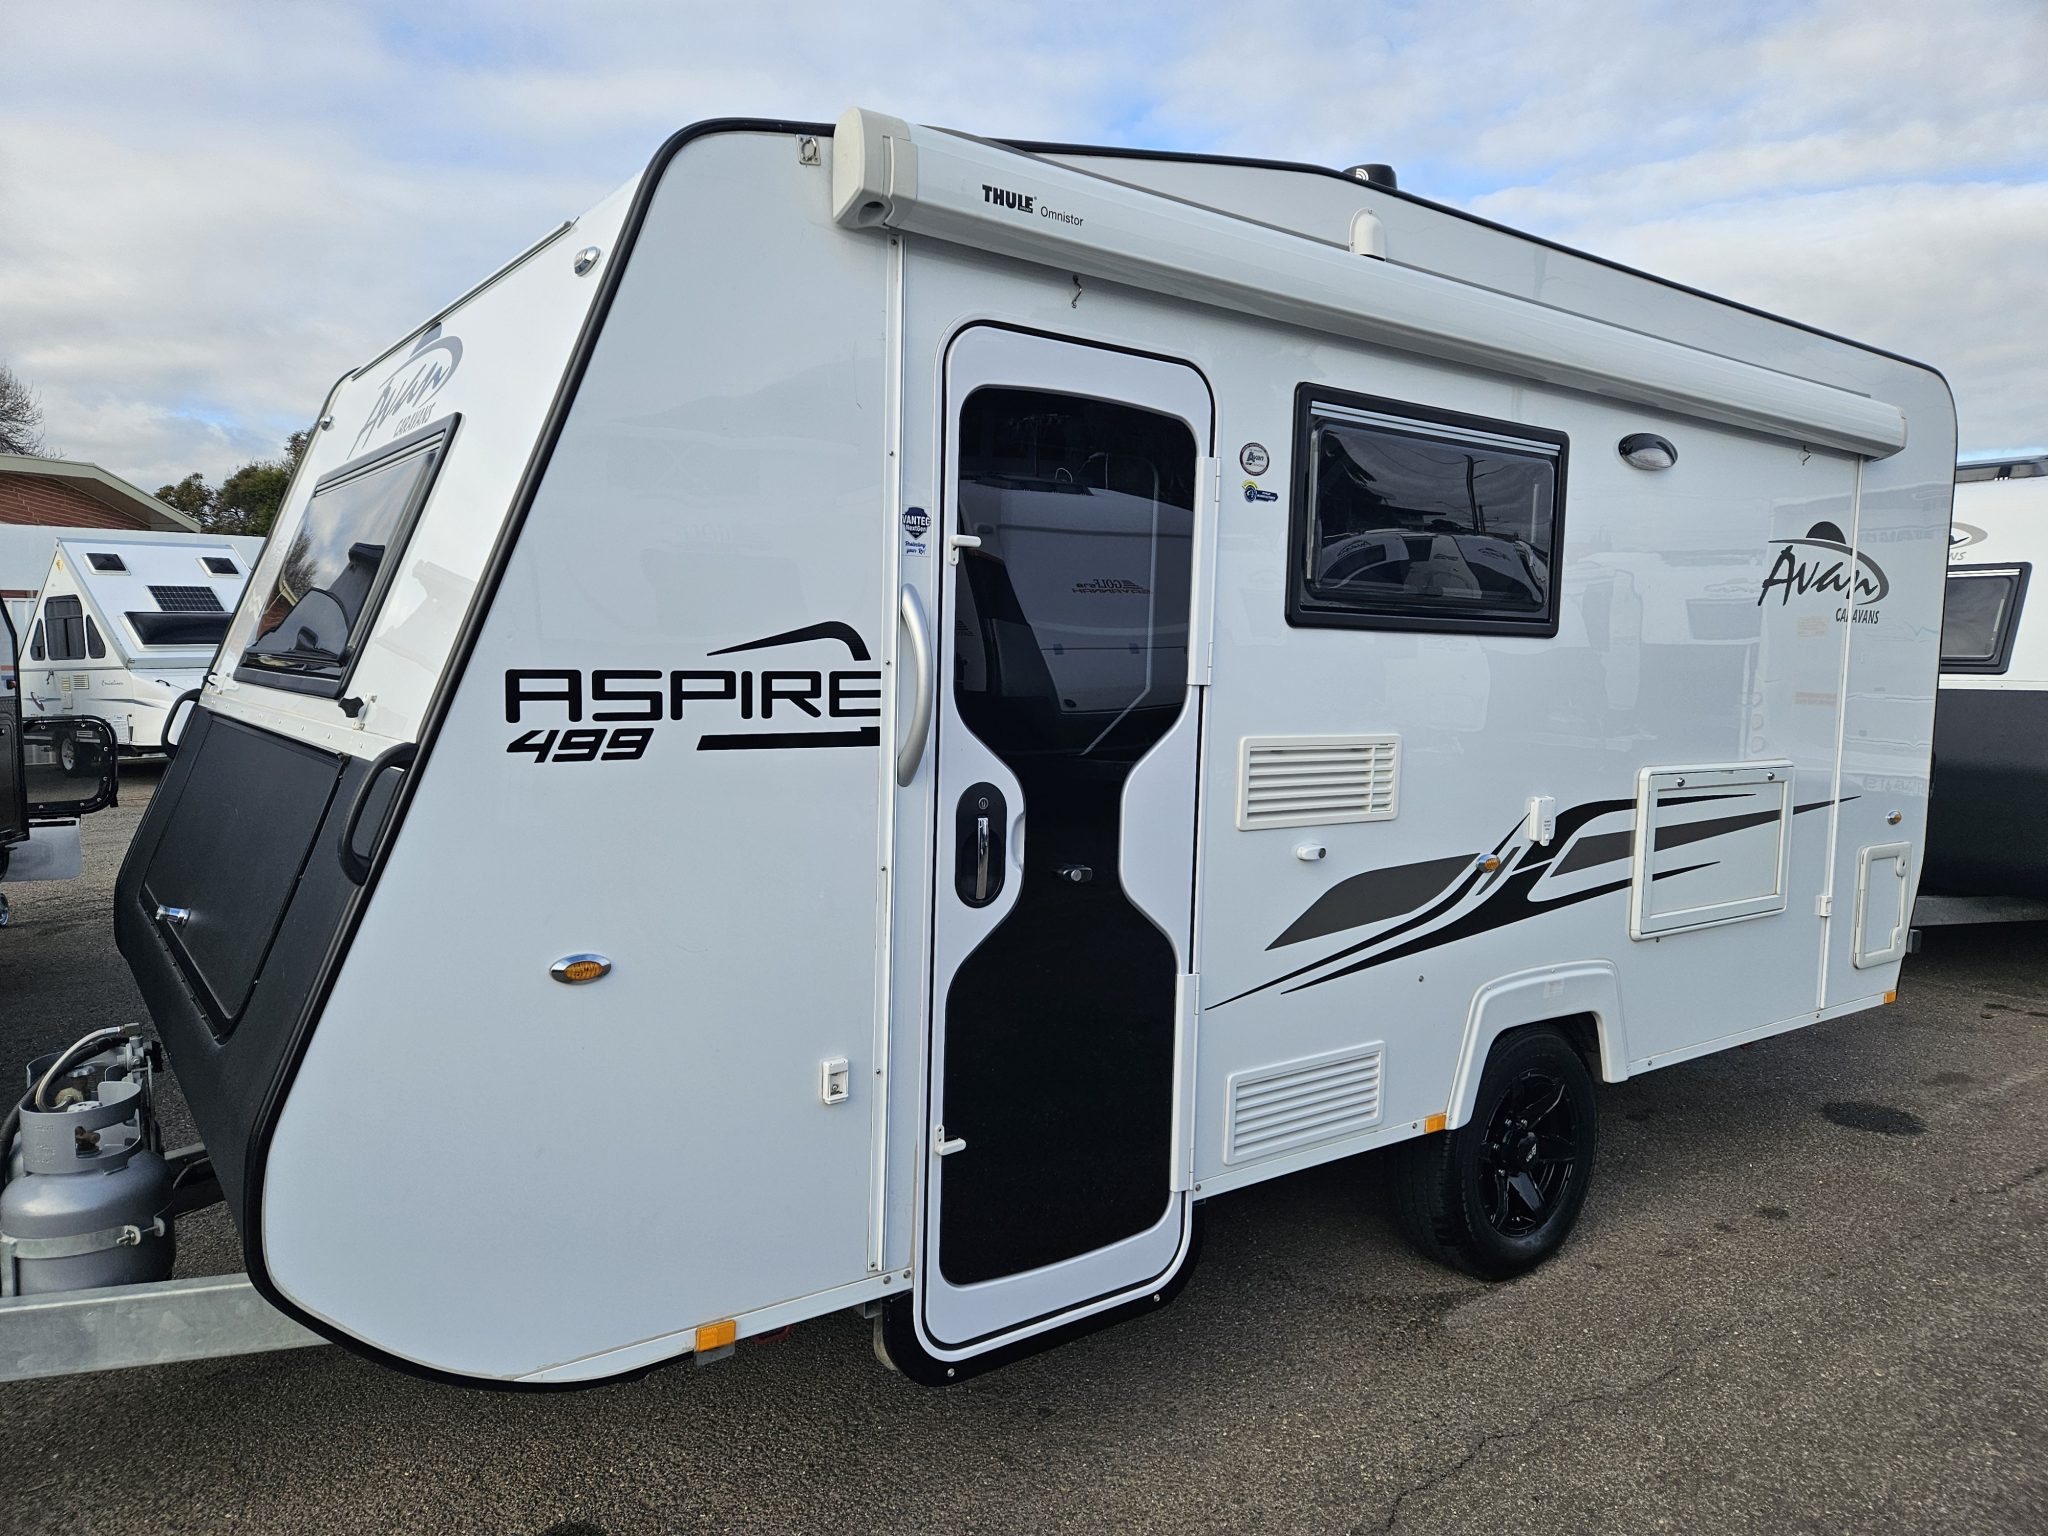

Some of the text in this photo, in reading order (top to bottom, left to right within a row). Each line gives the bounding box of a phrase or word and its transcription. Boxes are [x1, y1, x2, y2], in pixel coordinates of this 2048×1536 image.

[982, 183, 1084, 226] THULE Omnistor
[393, 402, 436, 439] CARAVANS
[1758, 545, 1879, 606] Avan
[504, 668, 882, 723] ASPIRE
[506, 728, 655, 763] 499
